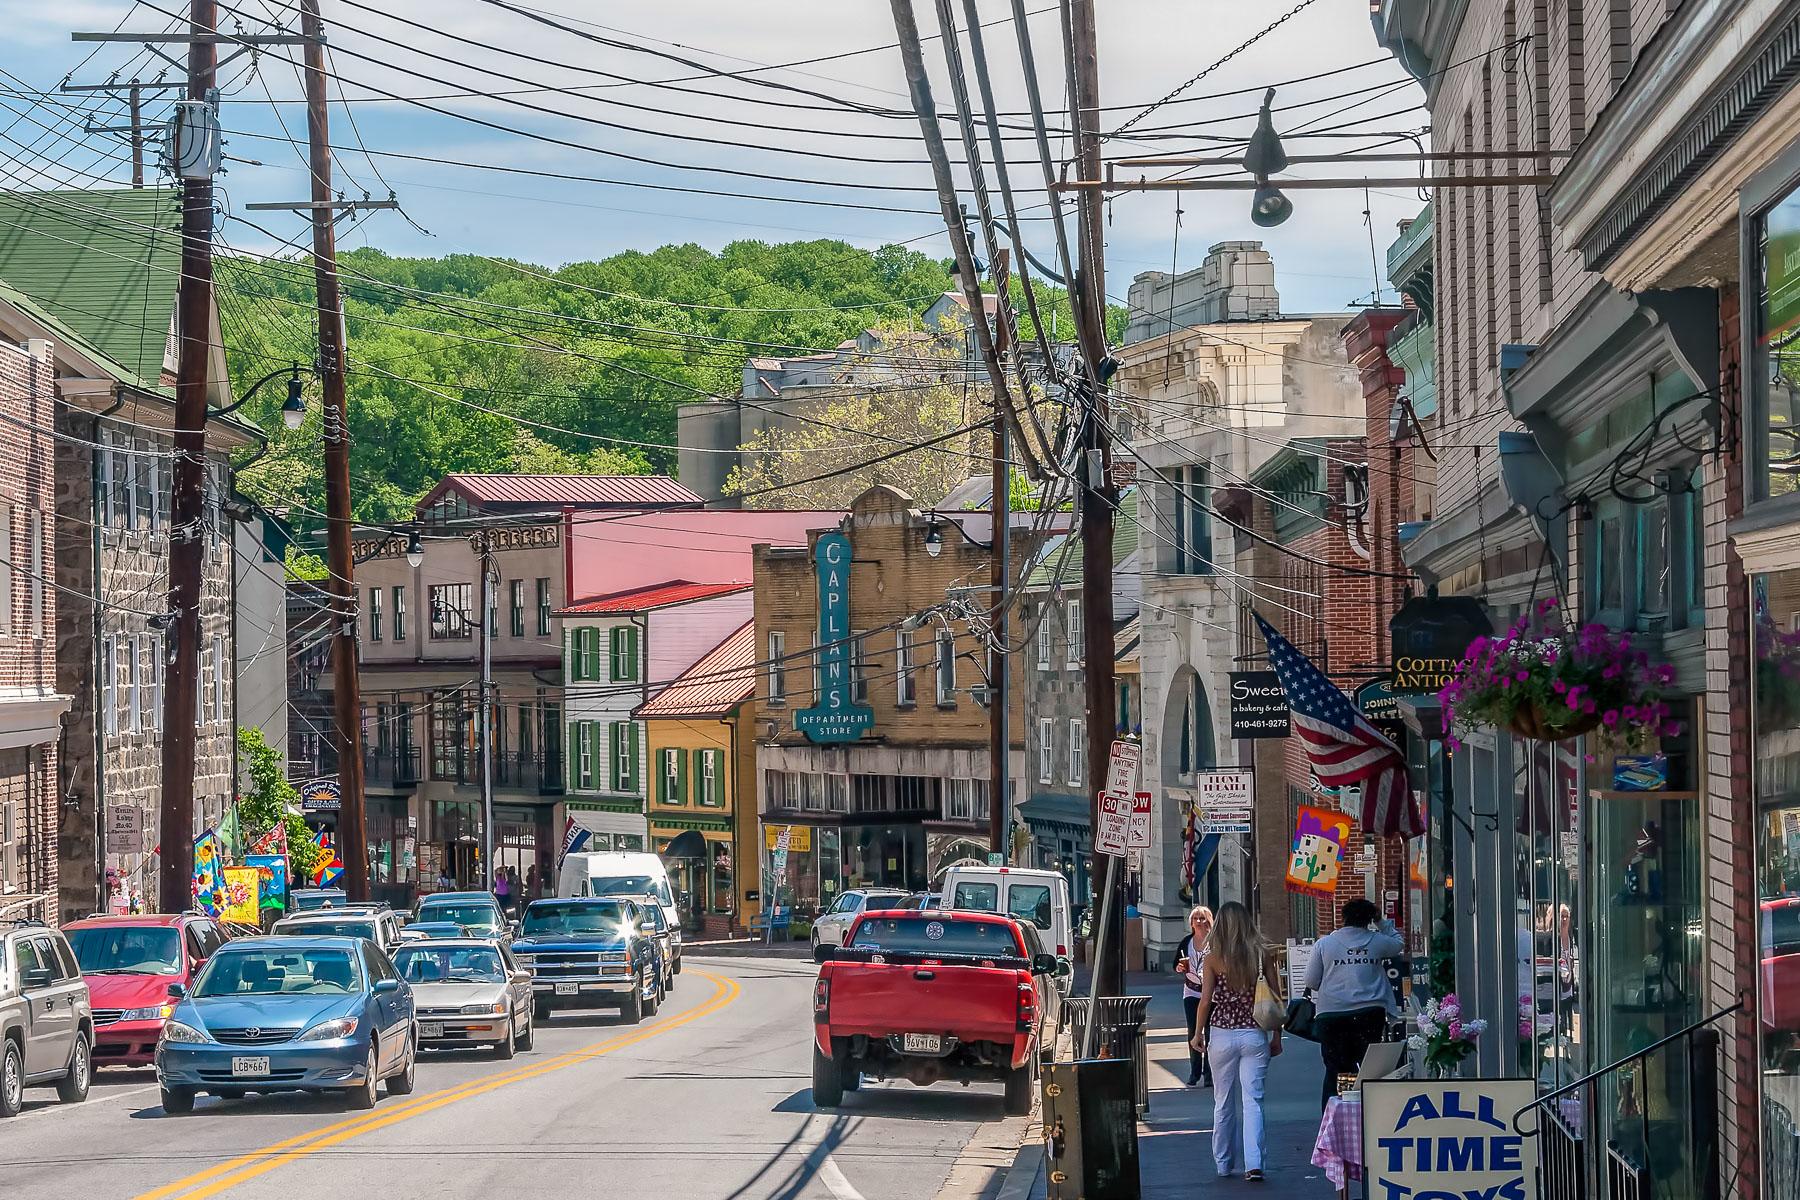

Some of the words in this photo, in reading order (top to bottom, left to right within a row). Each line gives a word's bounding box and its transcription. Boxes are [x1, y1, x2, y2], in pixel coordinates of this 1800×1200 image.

[1396, 656, 1470, 672] COTTA
[1394, 673, 1460, 688] ANTIQ
[1239, 703, 1264, 714] bakery
[802, 715, 868, 724] DEPARTMENT
[1234, 719, 1288, 729] 410-461-9275
[819, 727, 851, 736] STORE
[1113, 759, 1135, 770] ANYTIME
[1117, 769, 1129, 778] FIRE
[1115, 779, 1129, 788] LANE
[1104, 799, 1117, 811] 30
[1106, 814, 1126, 825] LOADING
[1108, 824, 1122, 834] ZONE
[1347, 948, 1369, 956] CPT
[1393, 1091, 1506, 1133] ALL
[1378, 1136, 1523, 1172] TIME
[1378, 1176, 1525, 1200] TS
